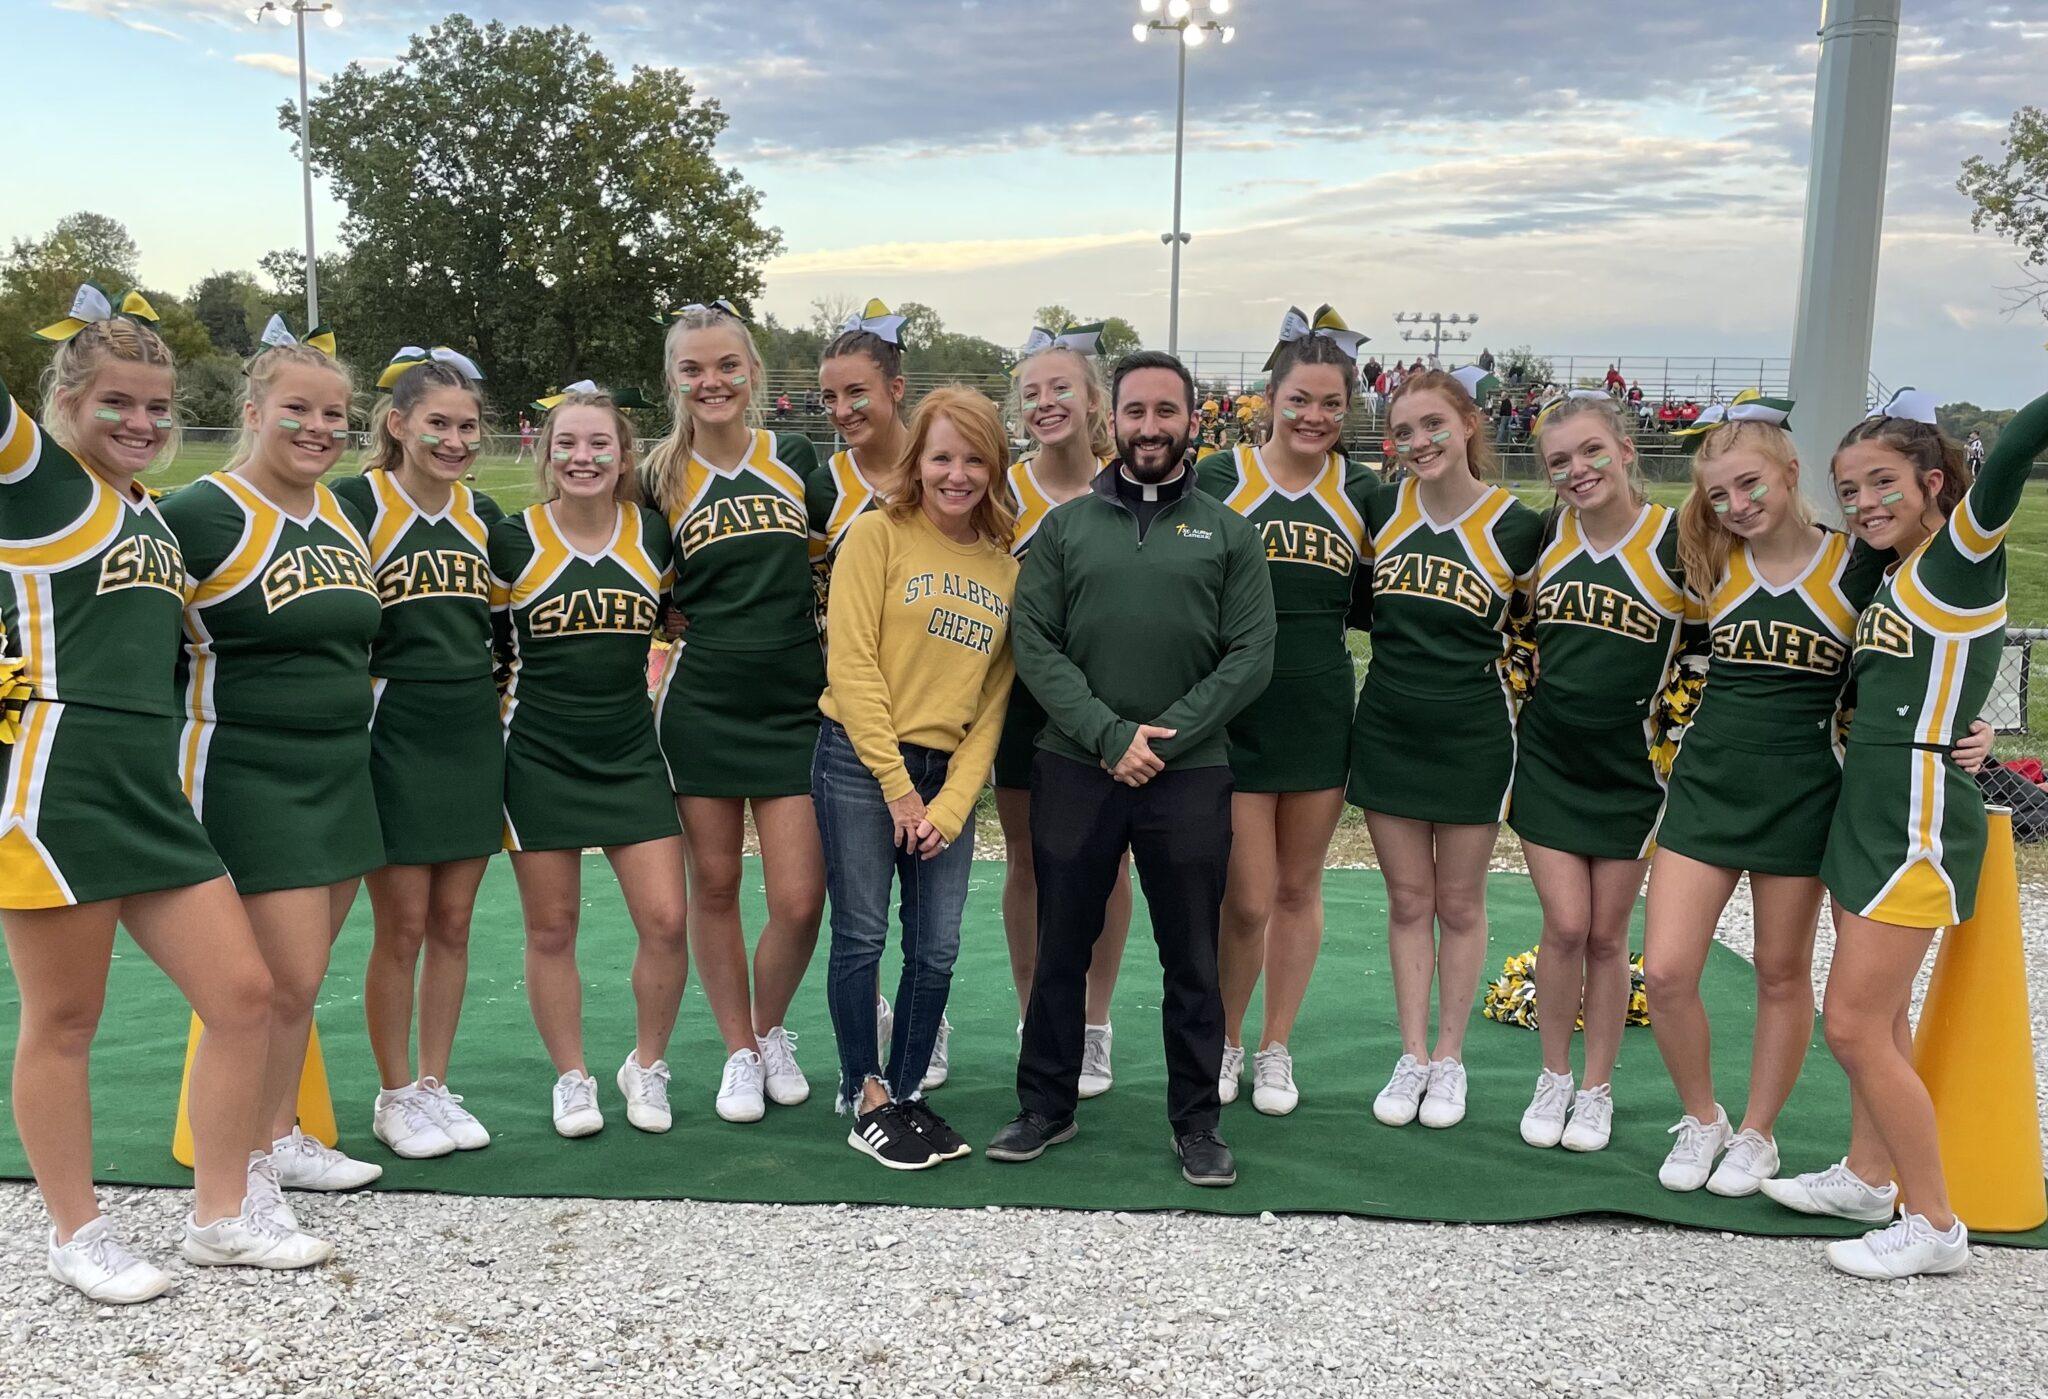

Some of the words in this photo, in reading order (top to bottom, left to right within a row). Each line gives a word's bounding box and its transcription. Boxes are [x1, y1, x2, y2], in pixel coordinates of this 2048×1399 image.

[680, 495, 808, 560] SAHS
[1254, 520, 1354, 576] AHS
[96, 535, 186, 604] SAH
[376, 550, 491, 609] SAHS
[904, 573, 938, 605] ST.
[1372, 553, 1493, 617] SAHS
[529, 588, 658, 638] SAHS
[926, 606, 995, 656] CHEER
[1536, 581, 1661, 643] SAHS
[1853, 602, 1914, 658] HS
[1711, 620, 1847, 676] SAHS
